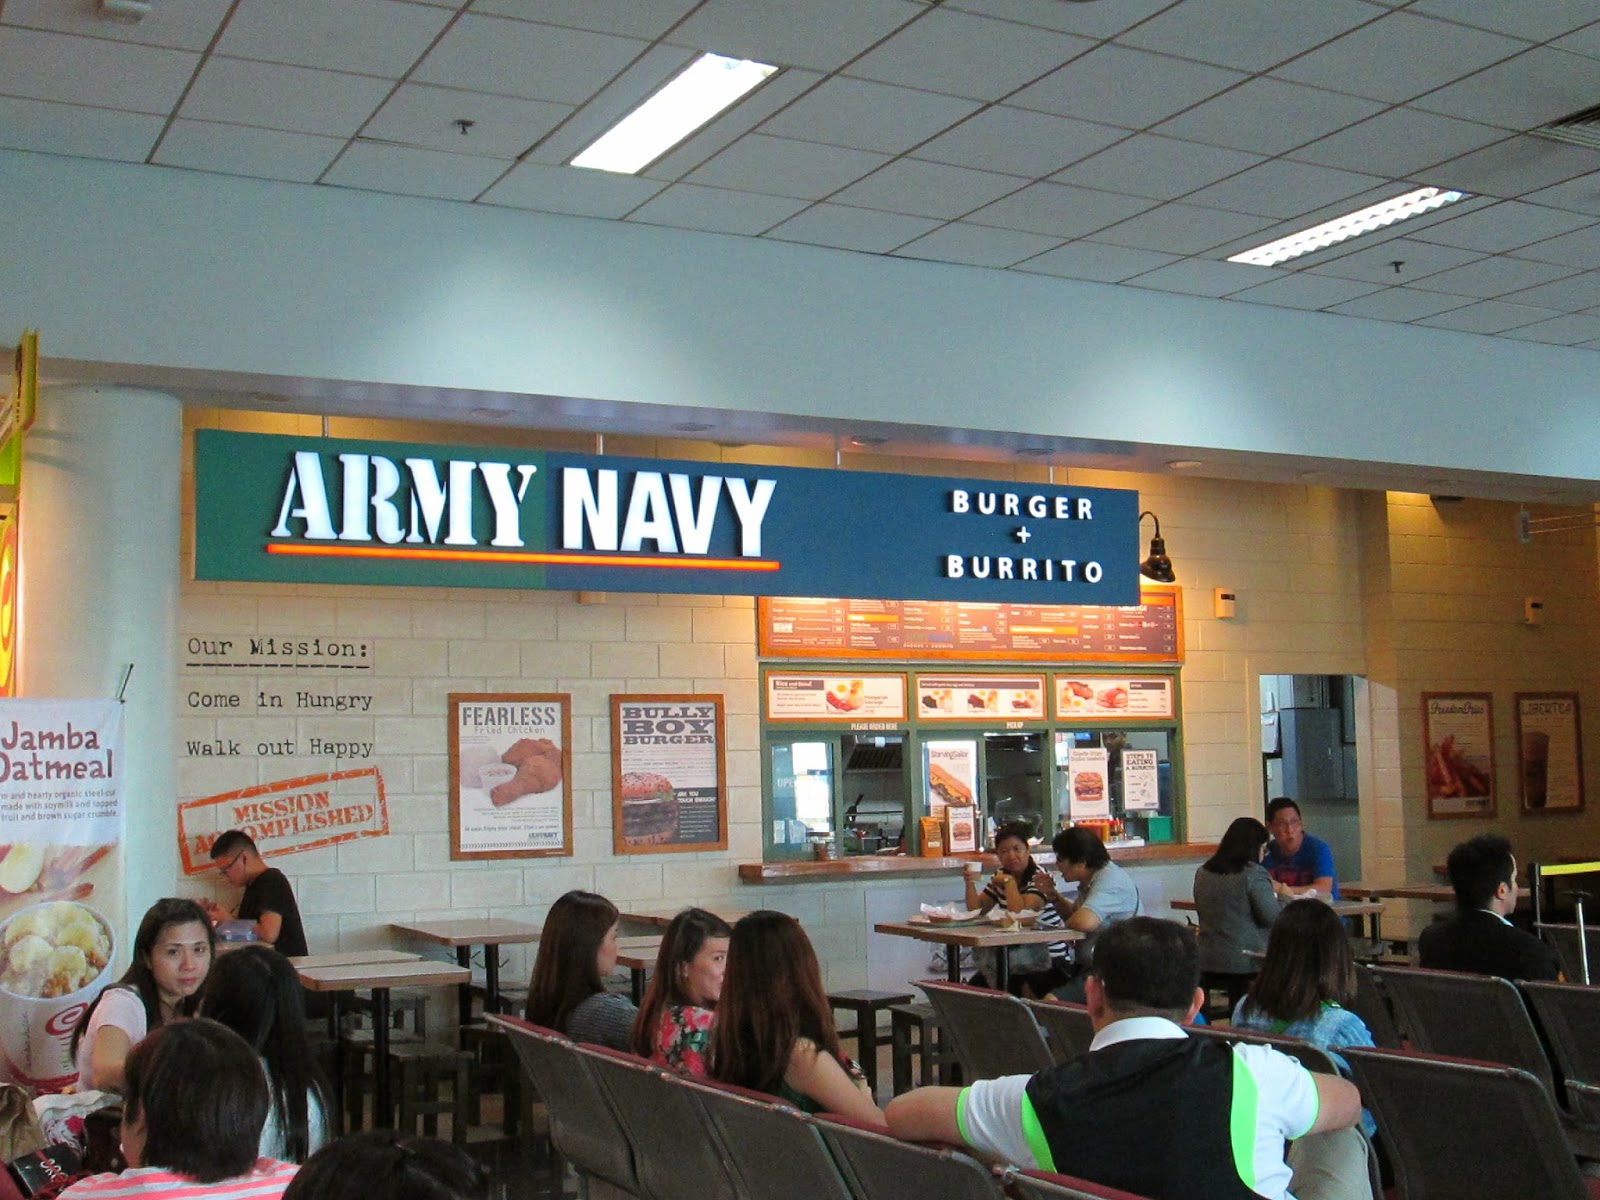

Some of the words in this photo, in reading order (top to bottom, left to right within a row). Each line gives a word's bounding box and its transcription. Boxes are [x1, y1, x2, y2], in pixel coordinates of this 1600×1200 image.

[270, 451, 537, 547] ARMY
[562, 467, 777, 557] NAVY
[952, 489, 1093, 520] BURGER
[947, 554, 1103, 584] BURRITO
[188, 637, 233, 655] Our
[250, 638, 367, 658] Mission:
[188, 691, 240, 708] Come
[258, 692, 283, 708] in
[296, 692, 373, 711] Hungry
[463, 706, 556, 726] FEARLESS
[623, 707, 713, 718] BULLY
[1, 721, 100, 750] Jamba
[475, 726, 502, 734] Fried
[508, 726, 546, 735] Chicken
[623, 720, 714, 734] BOY
[187, 740, 240, 756] Walk
[257, 739, 295, 755] out
[310, 738, 373, 759] Happy
[623, 735, 714, 744] BURGER
[1, 802, 22, 810] made
[25, 801, 42, 809] with
[45, 800, 73, 810] soymilk
[75, 799, 91, 807] and
[11, 791, 25, 799] and
[27, 791, 52, 800] hearty
[21, 811, 36, 820] and
[38, 811, 61, 820] brown
[64, 810, 85, 819] sugar
[233, 791, 331, 825] MISSION
[194, 804, 374, 854] ACOMPLISHED
